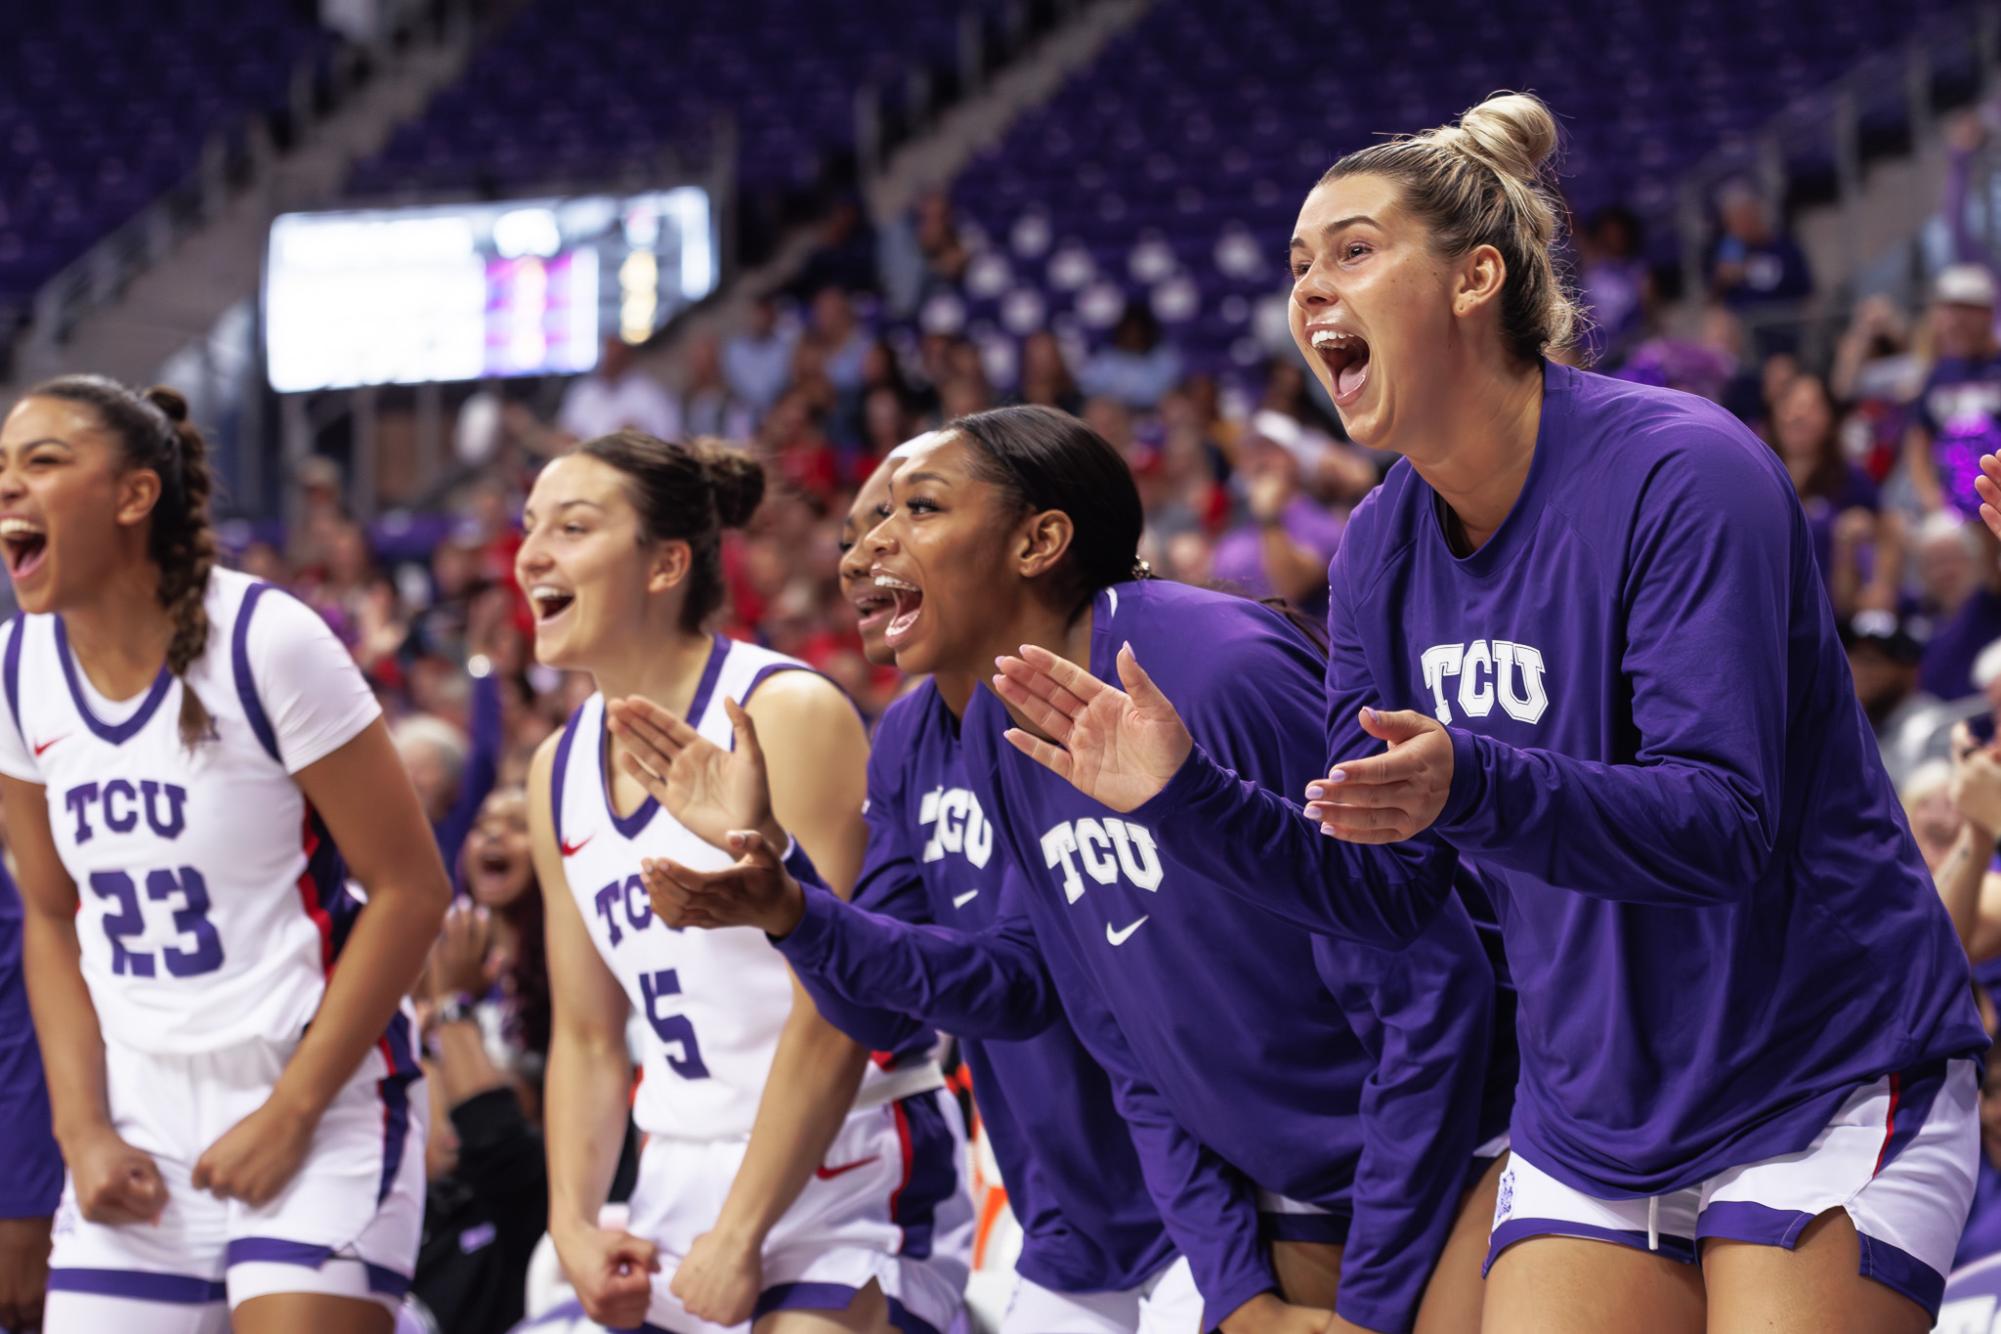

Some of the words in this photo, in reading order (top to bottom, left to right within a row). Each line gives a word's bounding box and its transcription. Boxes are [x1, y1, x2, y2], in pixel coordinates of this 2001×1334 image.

[1421, 639, 1549, 725] TCU
[65, 779, 187, 845] TCU
[919, 785, 993, 869] TCU
[1040, 817, 1164, 905] TCU
[89, 865, 225, 978] 23
[595, 874, 685, 948] TC
[639, 968, 710, 1080] 5
